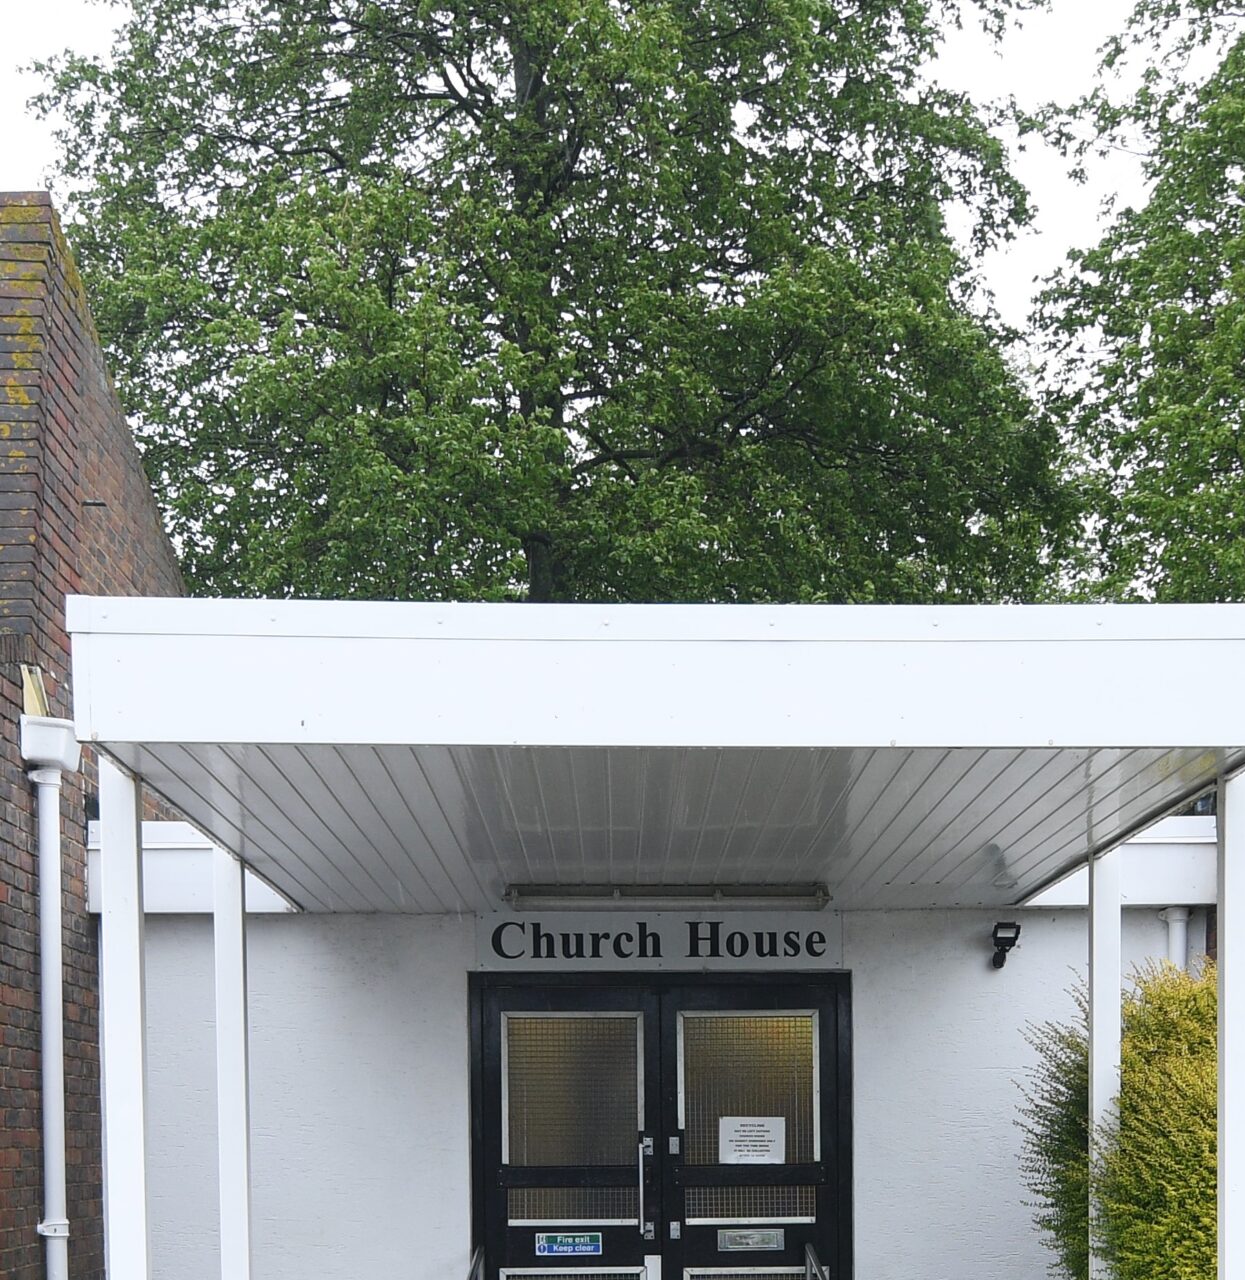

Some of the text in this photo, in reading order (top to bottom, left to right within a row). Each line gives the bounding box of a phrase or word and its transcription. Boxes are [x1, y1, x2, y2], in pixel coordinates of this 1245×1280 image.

[490, 921, 827, 959] Church House
[557, 1235, 590, 1244] Fire exit
[553, 1244, 595, 1253] Keep clear
